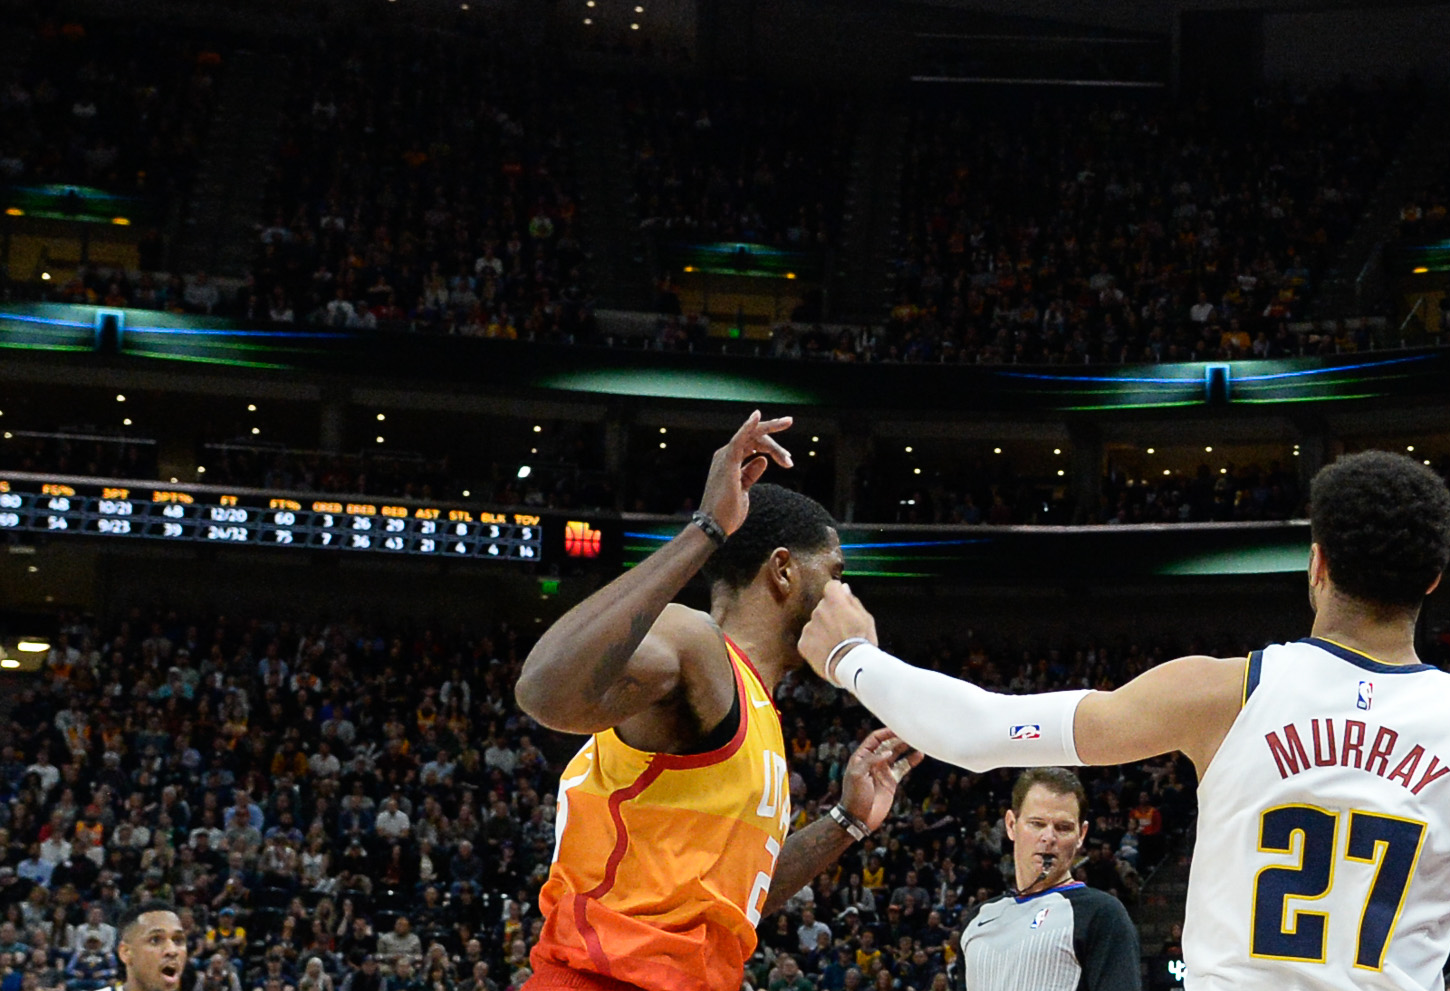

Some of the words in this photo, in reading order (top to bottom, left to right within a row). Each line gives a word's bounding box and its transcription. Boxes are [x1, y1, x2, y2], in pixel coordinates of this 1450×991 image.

[48, 497, 70, 511] 48
[98, 500, 133, 515] 10/21
[163, 504, 184, 518] 48
[210, 507, 248, 523] 12/20
[274, 511, 295, 526] 60
[323, 514, 334, 528] 3
[352, 516, 371, 531] 26
[386, 519, 405, 532] 29
[421, 520, 436, 534] 21
[456, 523, 468, 536] 8
[490, 525, 500, 538] 3
[522, 527, 532, 540] 5
[102, 488, 130, 499] 3PT
[221, 496, 238, 507] FT
[415, 509, 440, 520] AST
[449, 510, 473, 522] STL
[481, 512, 507, 524] BLK
[514, 514, 540, 526] TOV
[48, 515, 68, 530] 54
[98, 518, 131, 534] 9/23
[163, 522, 183, 537] 39
[207, 525, 248, 541] 24/32
[275, 529, 293, 544] 75
[322, 532, 332, 545] 7
[352, 534, 371, 549] 36
[385, 536, 404, 550] 43
[420, 538, 435, 552] 21
[455, 541, 466, 554] 4
[488, 543, 499, 556] 4
[519, 545, 534, 558] 14
[1265, 718, 1450, 796] MURRAY
[1249, 802, 1428, 973] 27
